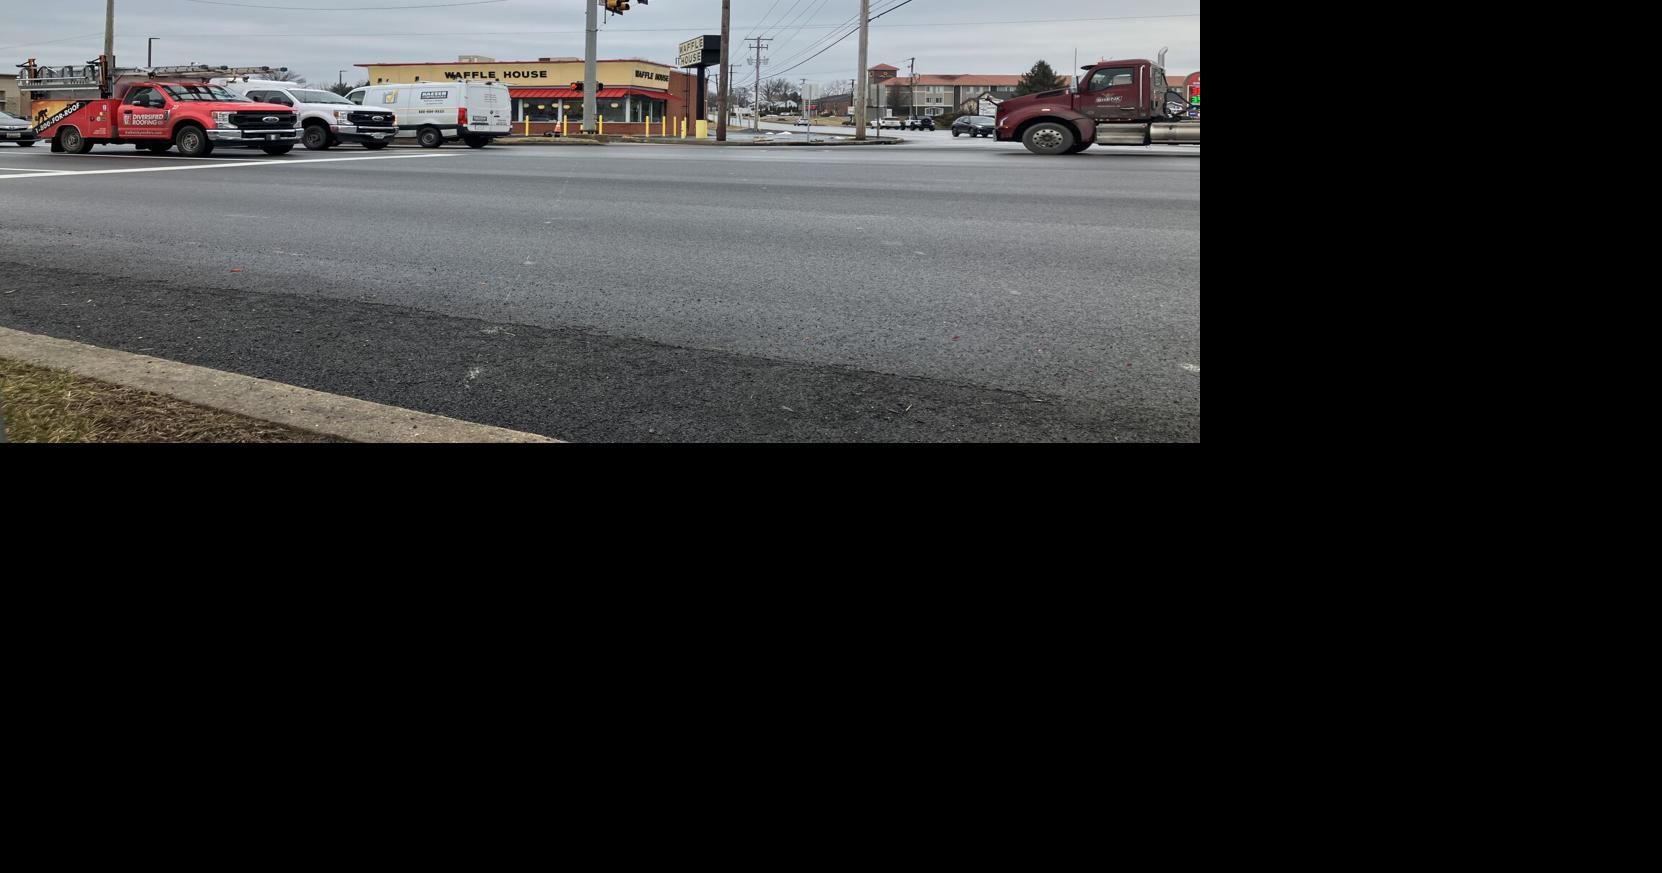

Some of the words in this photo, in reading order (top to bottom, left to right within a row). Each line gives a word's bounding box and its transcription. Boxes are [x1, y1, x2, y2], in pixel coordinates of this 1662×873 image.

[680, 52, 701, 65] HOUSE
[444, 71, 496, 79] WAFFLE
[503, 70, 548, 78] HOUSE
[635, 70, 653, 79] WAFFLE
[654, 73, 669, 82] HOUSE
